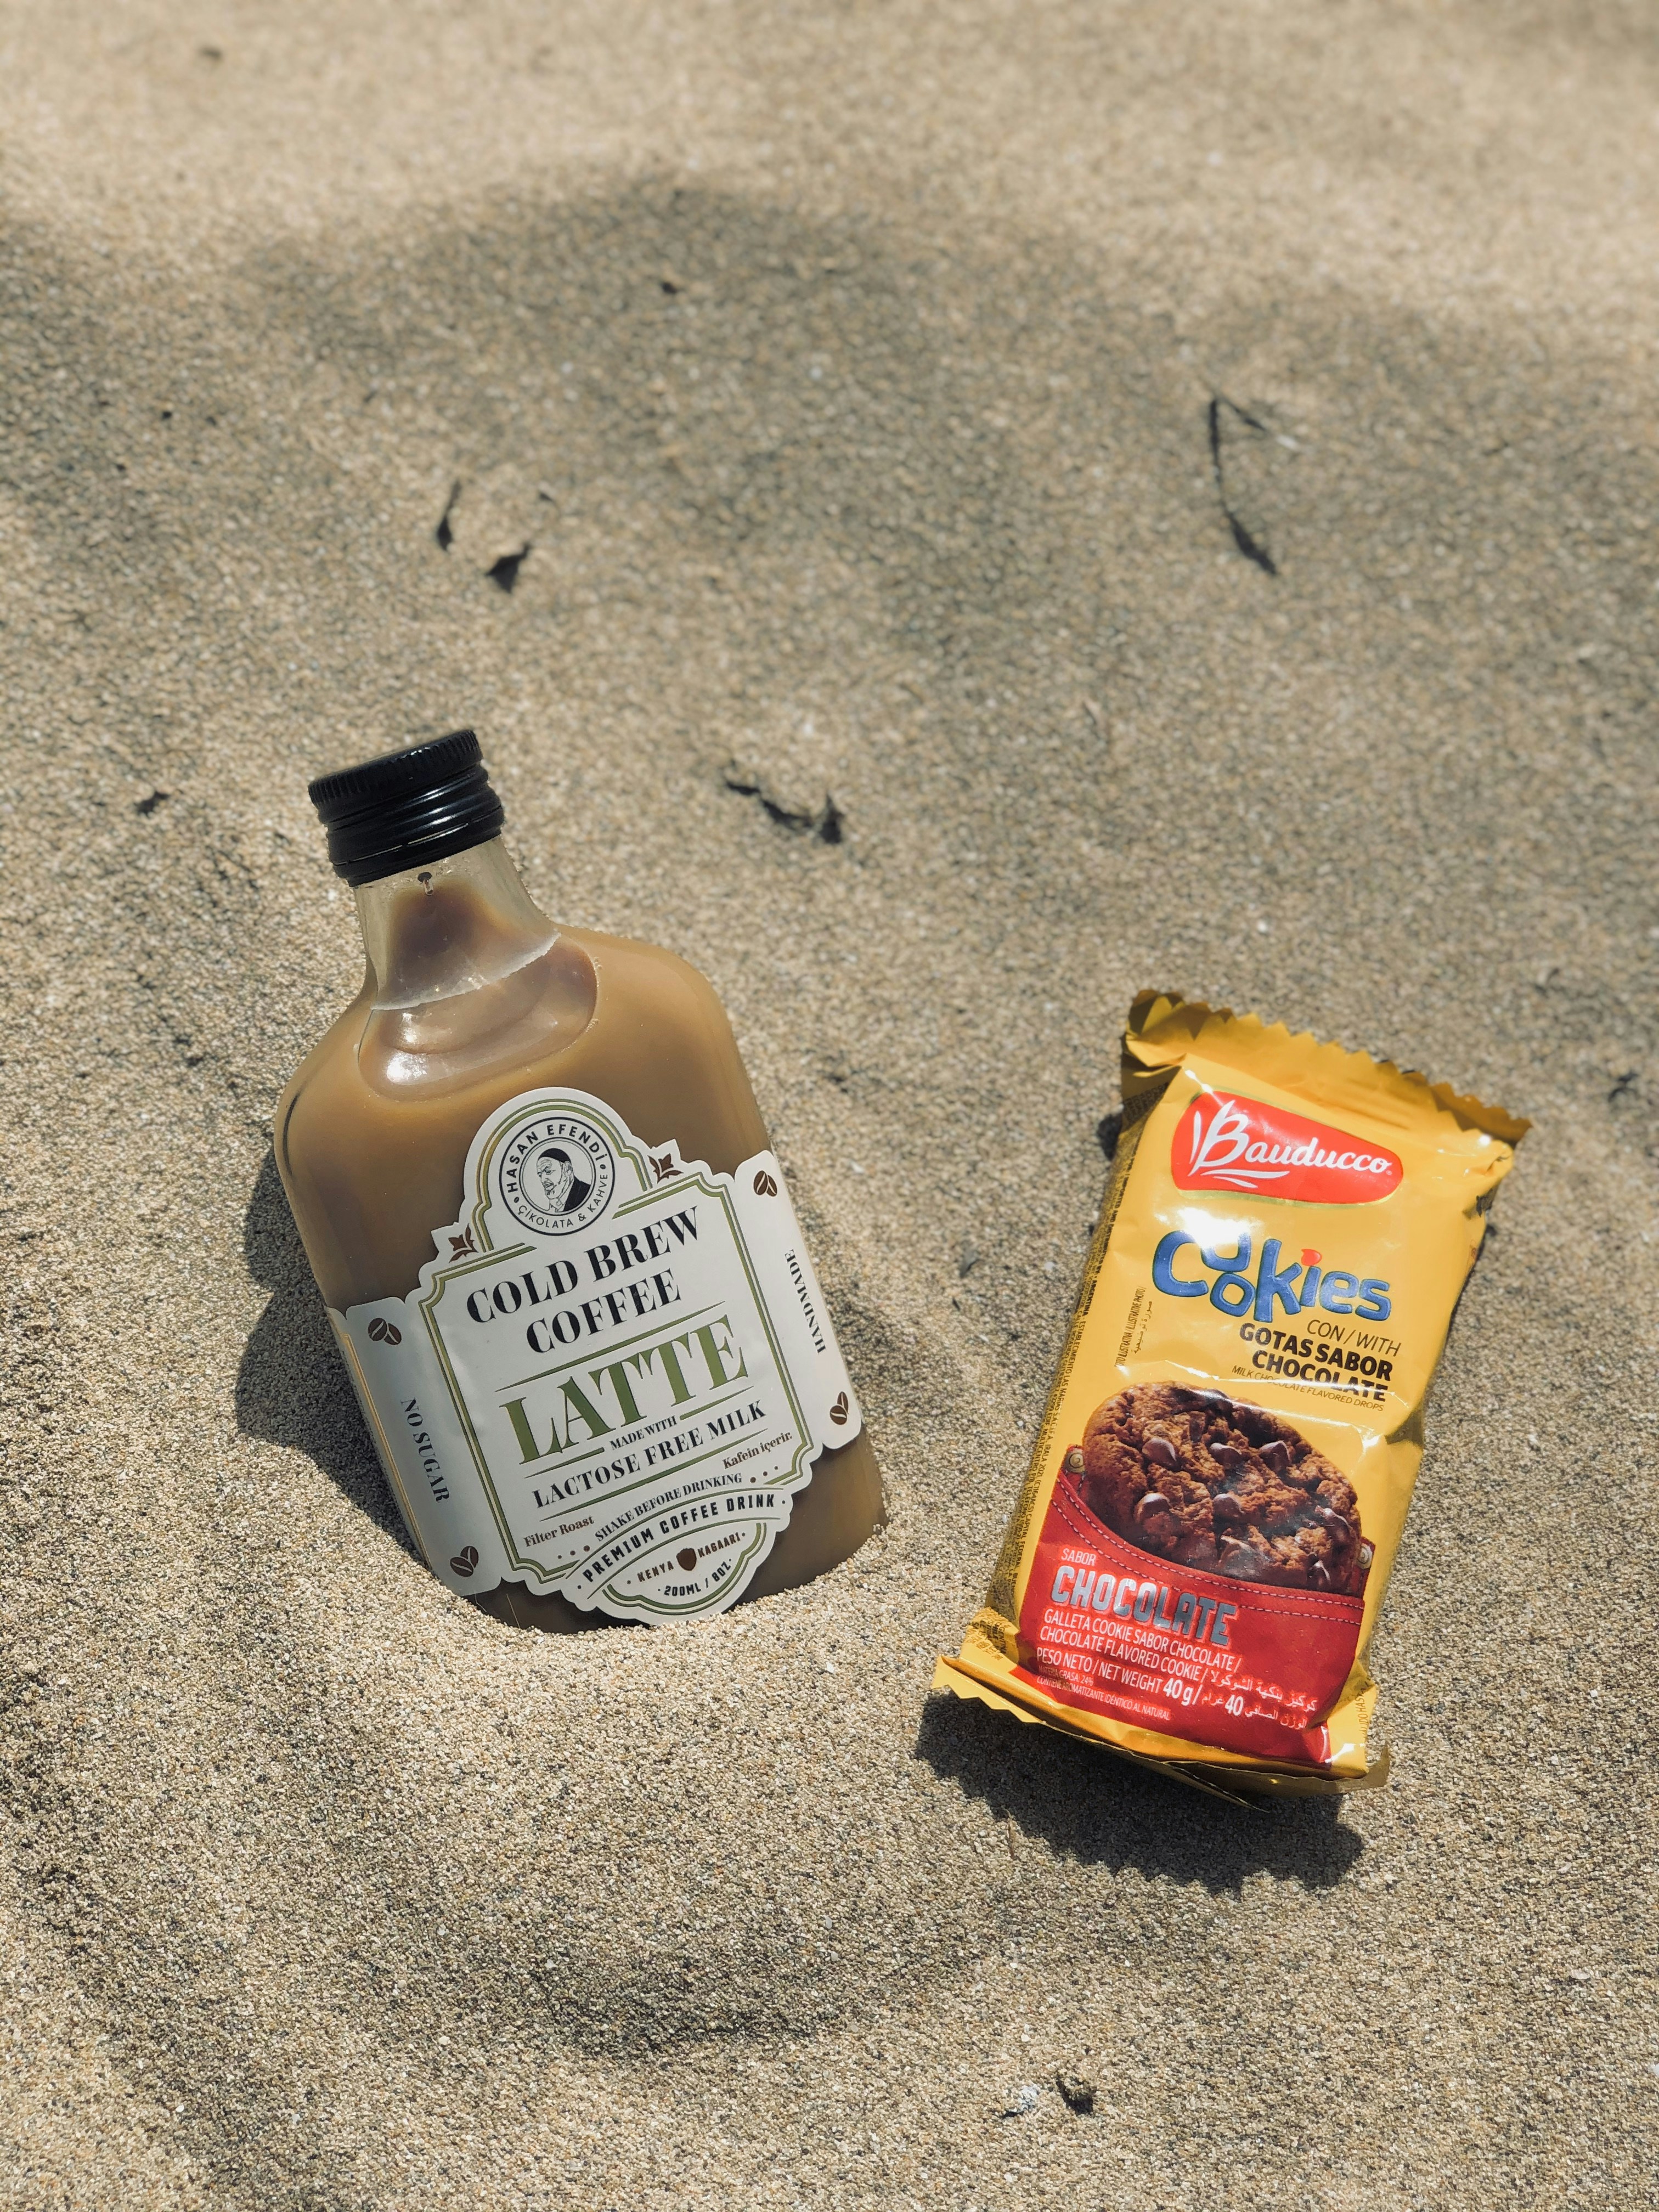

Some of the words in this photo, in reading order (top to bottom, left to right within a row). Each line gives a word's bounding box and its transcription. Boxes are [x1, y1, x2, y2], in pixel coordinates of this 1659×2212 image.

[506, 1131, 539, 1193] HASAN
[547, 1124, 608, 1163] EFENDİ
[1188, 1100, 1393, 1177] Bauducco
[517, 1198, 574, 1228] ÇİKOLATA
[578, 1213, 587, 1222] &
[588, 1173, 608, 1213] KAHVE
[466, 1261, 578, 1323] COLD
[584, 1205, 698, 1282] BREW
[1152, 1227, 1392, 1323] Cookies
[526, 1268, 681, 1353] COFFEE
[784, 1249, 826, 1355] HANDMADE
[1065, 1319, 1086, 1374] ESTABLECIMIENTO
[1239, 1322, 1313, 1358] GOTAS
[1315, 1344, 1393, 1381] SABOR
[1307, 1319, 1345, 1341] CON
[1357, 1331, 1402, 1357] WITH
[499, 1314, 748, 1465] LATTE
[1062, 1374, 1070, 1387] LAS
[1232, 1365, 1253, 1378] MILK
[1307, 1387, 1353, 1404] FLAVORED
[1353, 1398, 1384, 1412] DROPS
[1252, 1350, 1388, 1402] CHOCOLATE
[400, 1397, 424, 1427] NO
[413, 1431, 450, 1503] SUGAR
[532, 1455, 641, 1509] LACTOSE
[640, 1426, 704, 1466] FREE
[706, 1399, 766, 1440] MILK
[610, 1429, 645, 1451] MADE
[645, 1415, 677, 1436] WITH
[722, 1448, 760, 1469] Kafein
[760, 1432, 793, 1453] içerir.
[523, 1530, 558, 1548] Filter
[560, 1515, 594, 1534] Roast
[595, 1513, 634, 1542] SHAKE
[635, 1487, 682, 1519] BEFORE
[683, 1472, 742, 1498] DRINKING
[582, 1528, 654, 1583] PREMIUM
[660, 1502, 719, 1534] COFFEE
[726, 1494, 775, 1512] DRINK
[637, 1561, 674, 1583] KENYA
[697, 1532, 741, 1558] KAGAARI
[1061, 1548, 1096, 1566] SABOR
[664, 1583, 701, 1596] 200ML
[1051, 1566, 1237, 1645] CHOCOLATE
[1040, 1626, 1104, 1652] CHOCOLATE
[1104, 1639, 1159, 1669] FLAVORED
[1160, 1656, 1203, 1681] COOKIE
[1044, 1609, 1091, 1631] GALLETA
[1092, 1618, 1133, 1641] COOKIE
[1134, 1629, 1167, 1652] SABOR
[1169, 1640, 1235, 1672] CHOCOLATE
[1036, 1647, 1062, 1666] PESO
[1062, 1652, 1093, 1672] NETO
[1098, 1661, 1121, 1681] NET
[1121, 1668, 1164, 1694] WEIGHT
[1080, 1675, 1093, 1686] 24%
[1132, 1702, 1141, 1713] AL
[1141, 1705, 1170, 1720] NATURAL
[1224, 1694, 1244, 1716] 40
